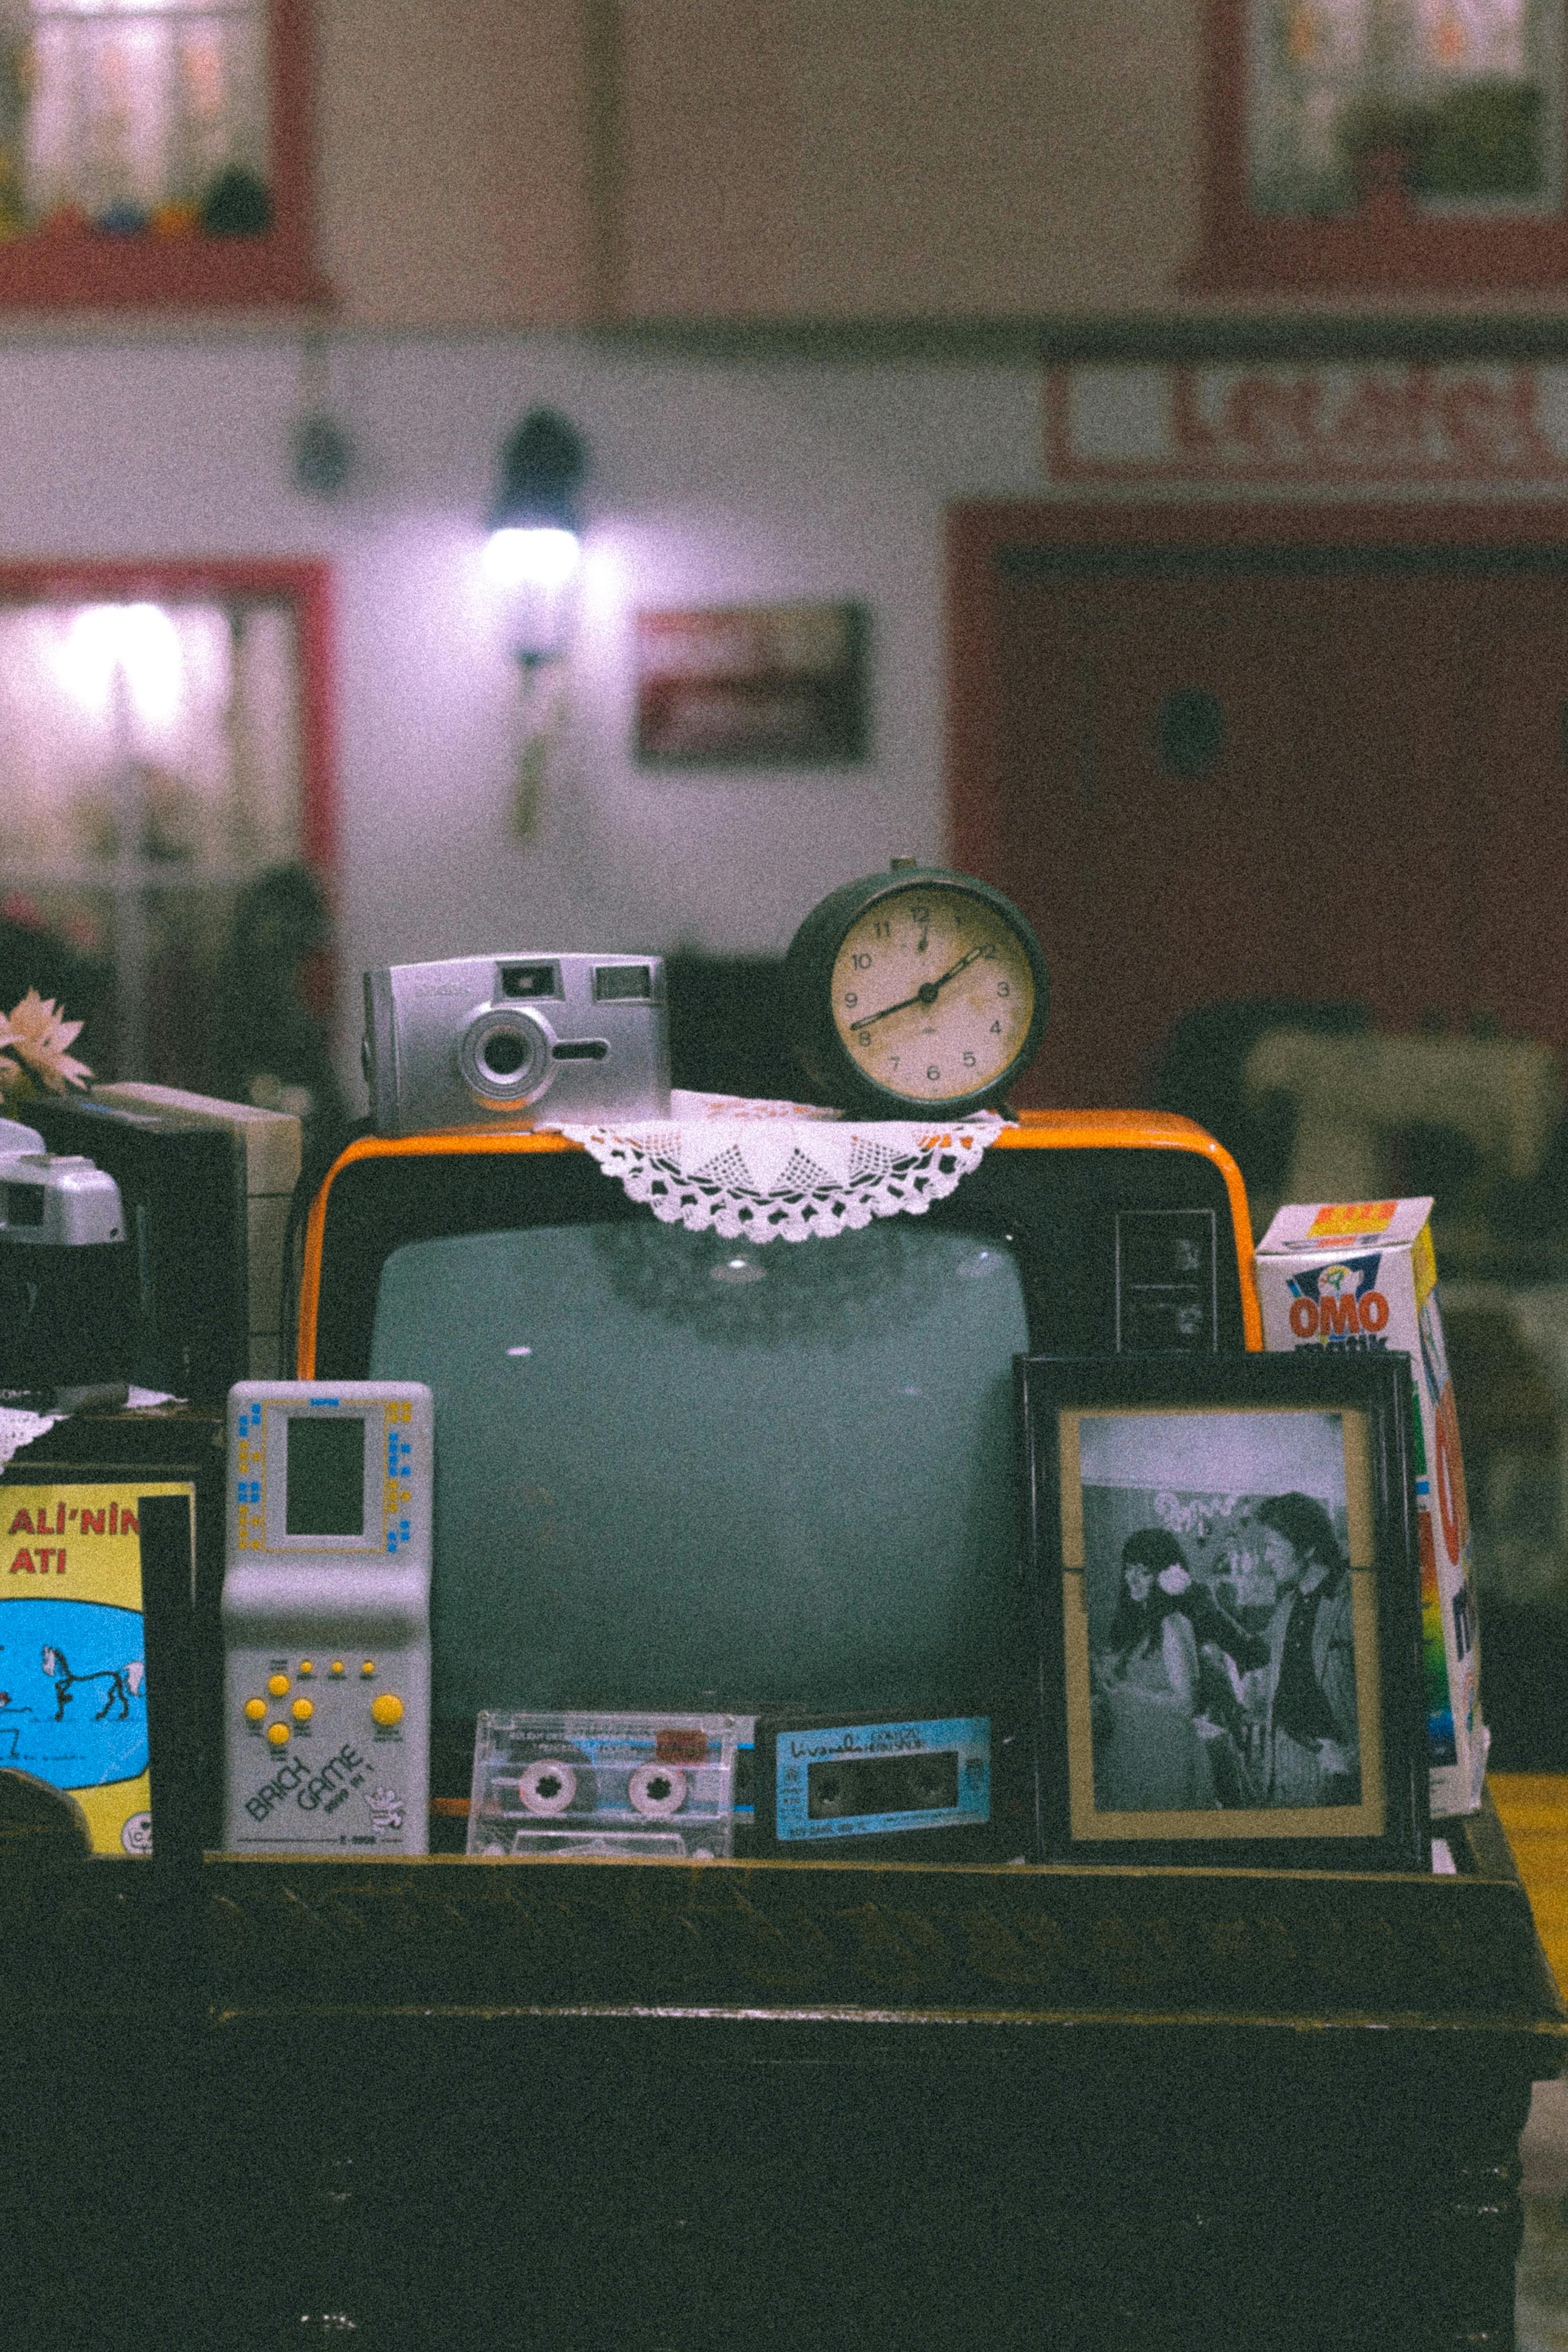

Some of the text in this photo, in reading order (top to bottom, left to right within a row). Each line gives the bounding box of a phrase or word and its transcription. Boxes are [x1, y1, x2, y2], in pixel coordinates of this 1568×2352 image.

[910, 906, 930, 922] 12
[874, 921, 890, 937] 11
[851, 953, 873, 970] 10
[997, 981, 1010, 998] 3
[844, 993, 858, 1009] 9
[989, 1020, 1002, 1035] 4
[858, 1031, 872, 1047] 8
[888, 1056, 901, 1071] 7
[962, 1052, 977, 1067] 5
[926, 1066, 941, 1081] 6
[1289, 1291, 1389, 1338] OMO
[10, 1549, 67, 1574] ATI
[297, 1744, 363, 1810] GAME
[245, 1756, 311, 1822] BRICK
